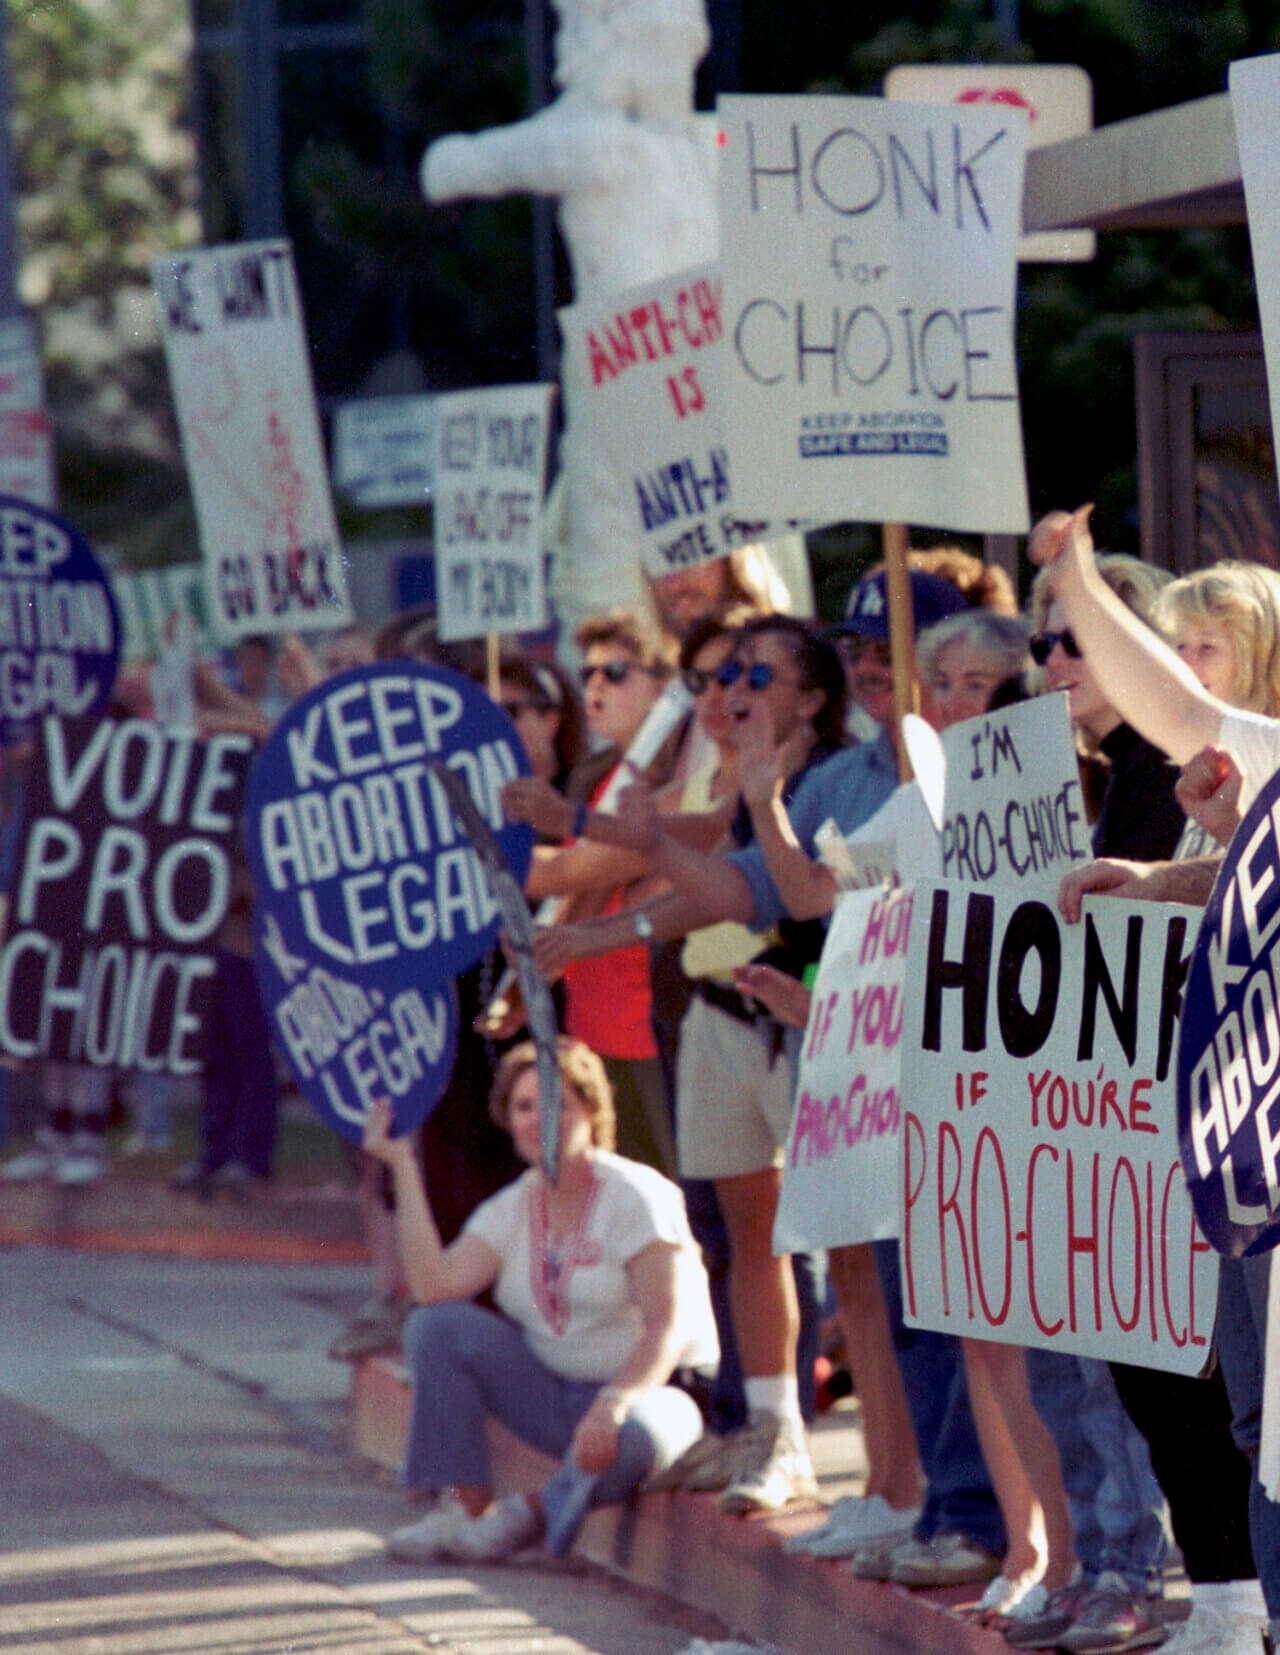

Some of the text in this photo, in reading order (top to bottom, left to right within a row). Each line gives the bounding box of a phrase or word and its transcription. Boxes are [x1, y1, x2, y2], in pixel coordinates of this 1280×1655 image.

[746, 121, 1006, 232] HONK
[666, 368, 706, 419] IS
[735, 298, 1017, 401] CHOICE
[44, 714, 254, 832] VOTE
[286, 676, 463, 788] KEEP
[971, 720, 1022, 780] I'M
[18, 818, 230, 942] PRO
[942, 780, 1086, 882] PRO-CHOICE
[0, 931, 217, 1075] CHOICE
[954, 1064, 1159, 1134] IF YOU'RE
[903, 1110, 1212, 1348] PRO-CHOICE
